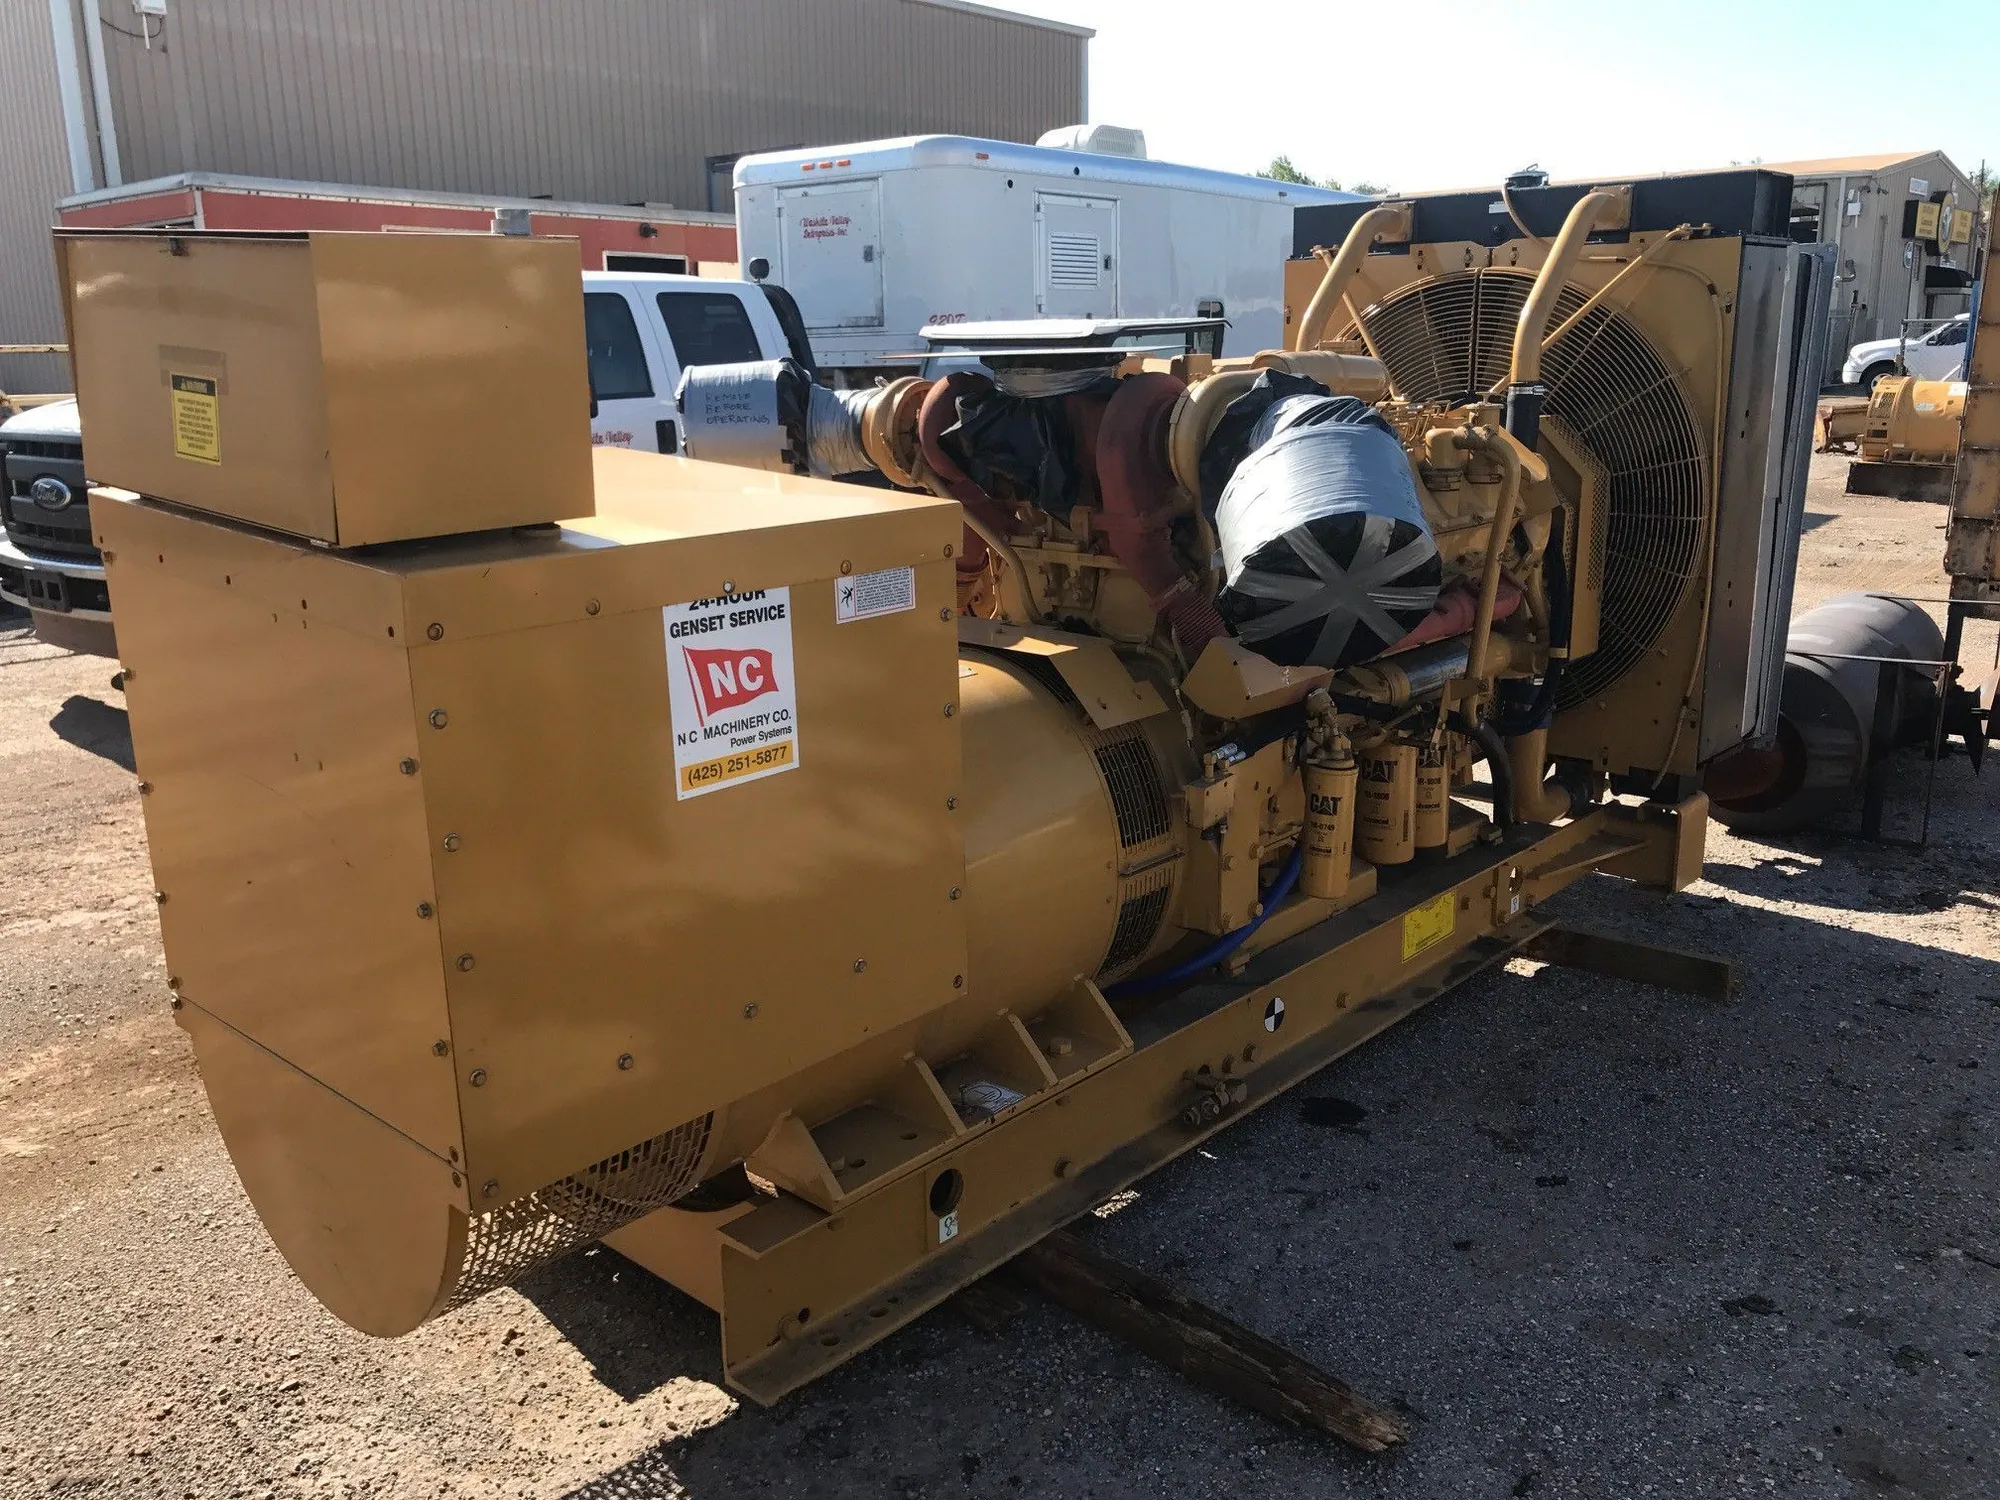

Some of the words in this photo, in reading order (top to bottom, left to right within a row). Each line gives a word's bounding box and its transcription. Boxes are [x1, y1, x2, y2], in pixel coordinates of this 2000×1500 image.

[706, 414, 770, 425] OPERATING
[688, 589, 766, 611] 24-HOUR
[669, 614, 725, 639] GENSET
[729, 604, 786, 628] SERVICE
[707, 656, 764, 698] NC
[703, 713, 770, 740] MACHINERY
[772, 708, 792, 723] CO.
[730, 734, 756, 748] Power
[758, 725, 793, 742] Systems
[688, 762, 723, 787] (425)
[727, 745, 788, 774] 251-5877
[1361, 759, 1398, 783] CAT
[1310, 793, 1343, 816] CAT
